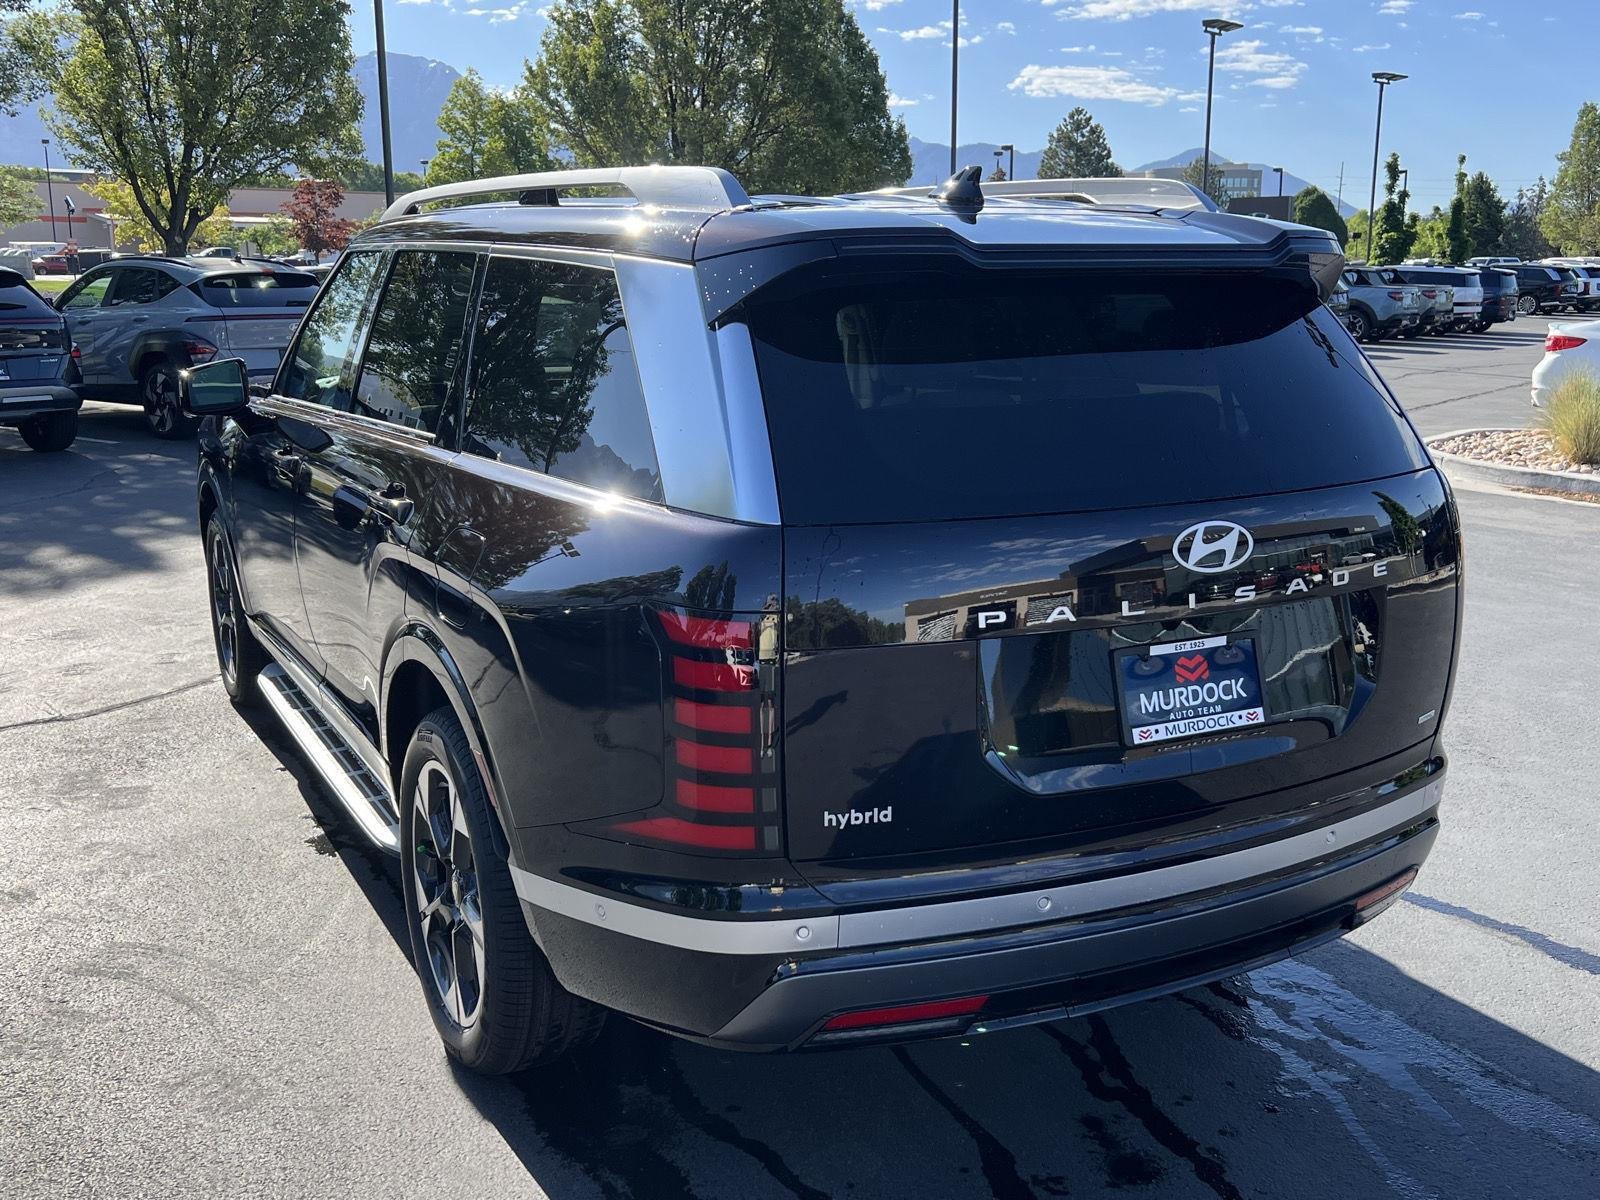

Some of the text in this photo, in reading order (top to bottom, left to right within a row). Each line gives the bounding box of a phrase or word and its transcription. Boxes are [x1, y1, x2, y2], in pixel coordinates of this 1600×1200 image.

[977, 562, 1388, 629] PALISADE
[1174, 641, 1205, 651] EST. 1925
[1139, 677, 1247, 714] MURDOCK
[1169, 705, 1222, 720] AUTO TEAM
[1164, 714, 1236, 737] MURDOCK
[823, 806, 892, 829] hybrid
